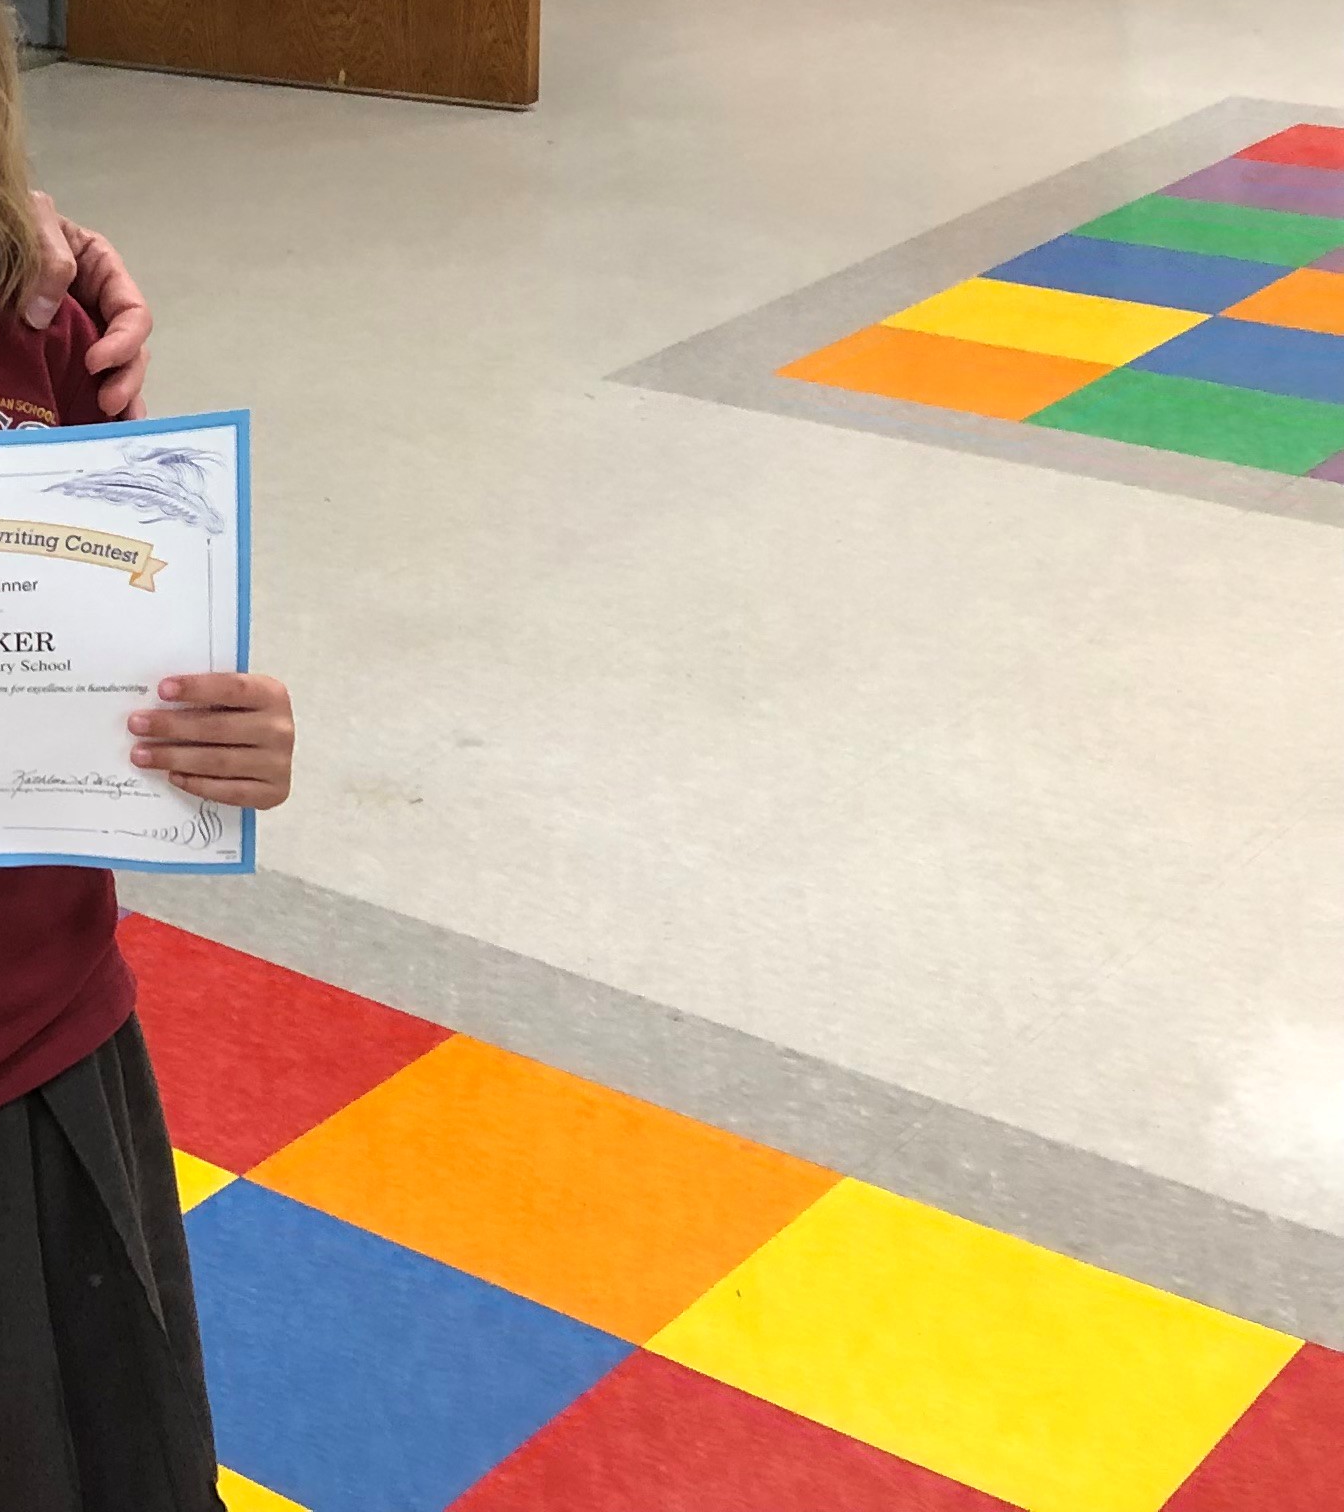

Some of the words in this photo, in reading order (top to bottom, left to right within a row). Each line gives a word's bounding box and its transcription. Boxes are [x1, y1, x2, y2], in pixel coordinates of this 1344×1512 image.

[16, 399, 57, 425] SCHOOL
[65, 534, 139, 565] Contest
[20, 659, 72, 672] School
[9, 683, 25, 696] for
[76, 684, 87, 693] in
